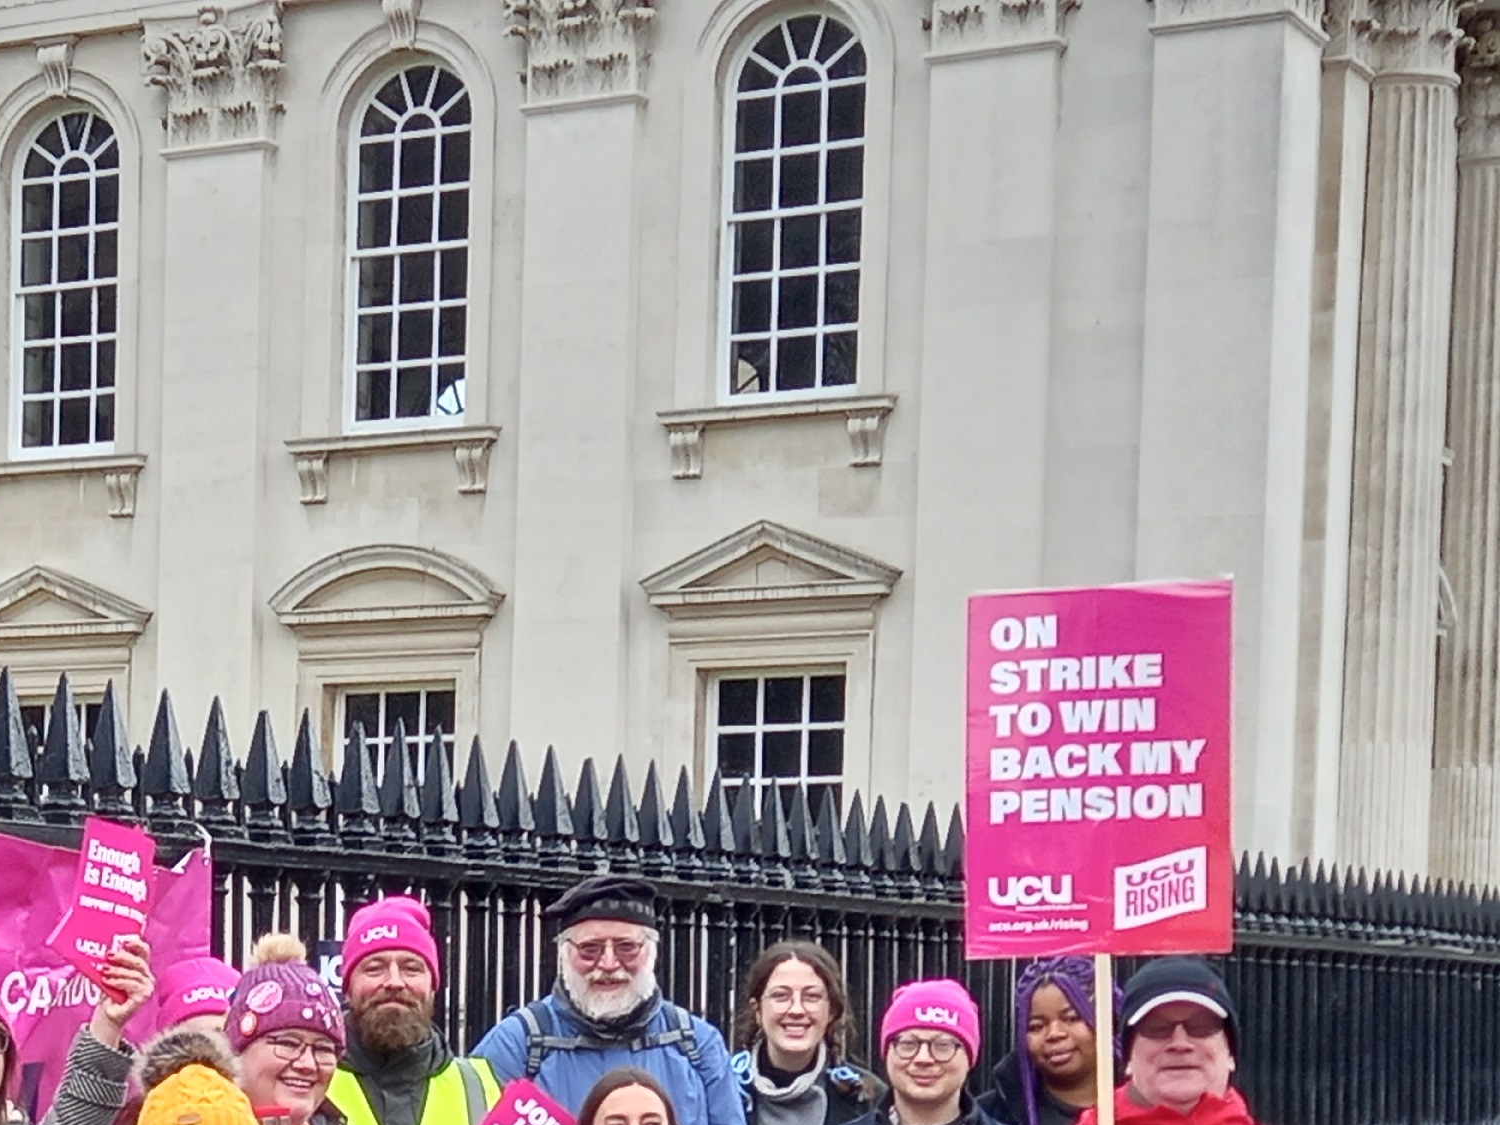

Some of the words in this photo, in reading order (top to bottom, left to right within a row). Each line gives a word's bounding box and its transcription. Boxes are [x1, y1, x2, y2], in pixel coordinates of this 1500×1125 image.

[990, 615, 1058, 650] ON
[989, 653, 1164, 693] STRIKE
[989, 702, 1052, 737] TO
[1059, 698, 1156, 734] WIN
[990, 743, 1124, 781] BACK
[1129, 739, 1207, 775] MY
[990, 784, 1203, 824] PENSION
[87, 838, 142, 874] Enough
[1126, 859, 1195, 887] UCU
[83, 862, 100, 886] is
[988, 874, 1073, 906] UCU
[1126, 876, 1195, 918] RISING
[360, 924, 398, 944] UCU
[915, 1006, 959, 1027] UCU
